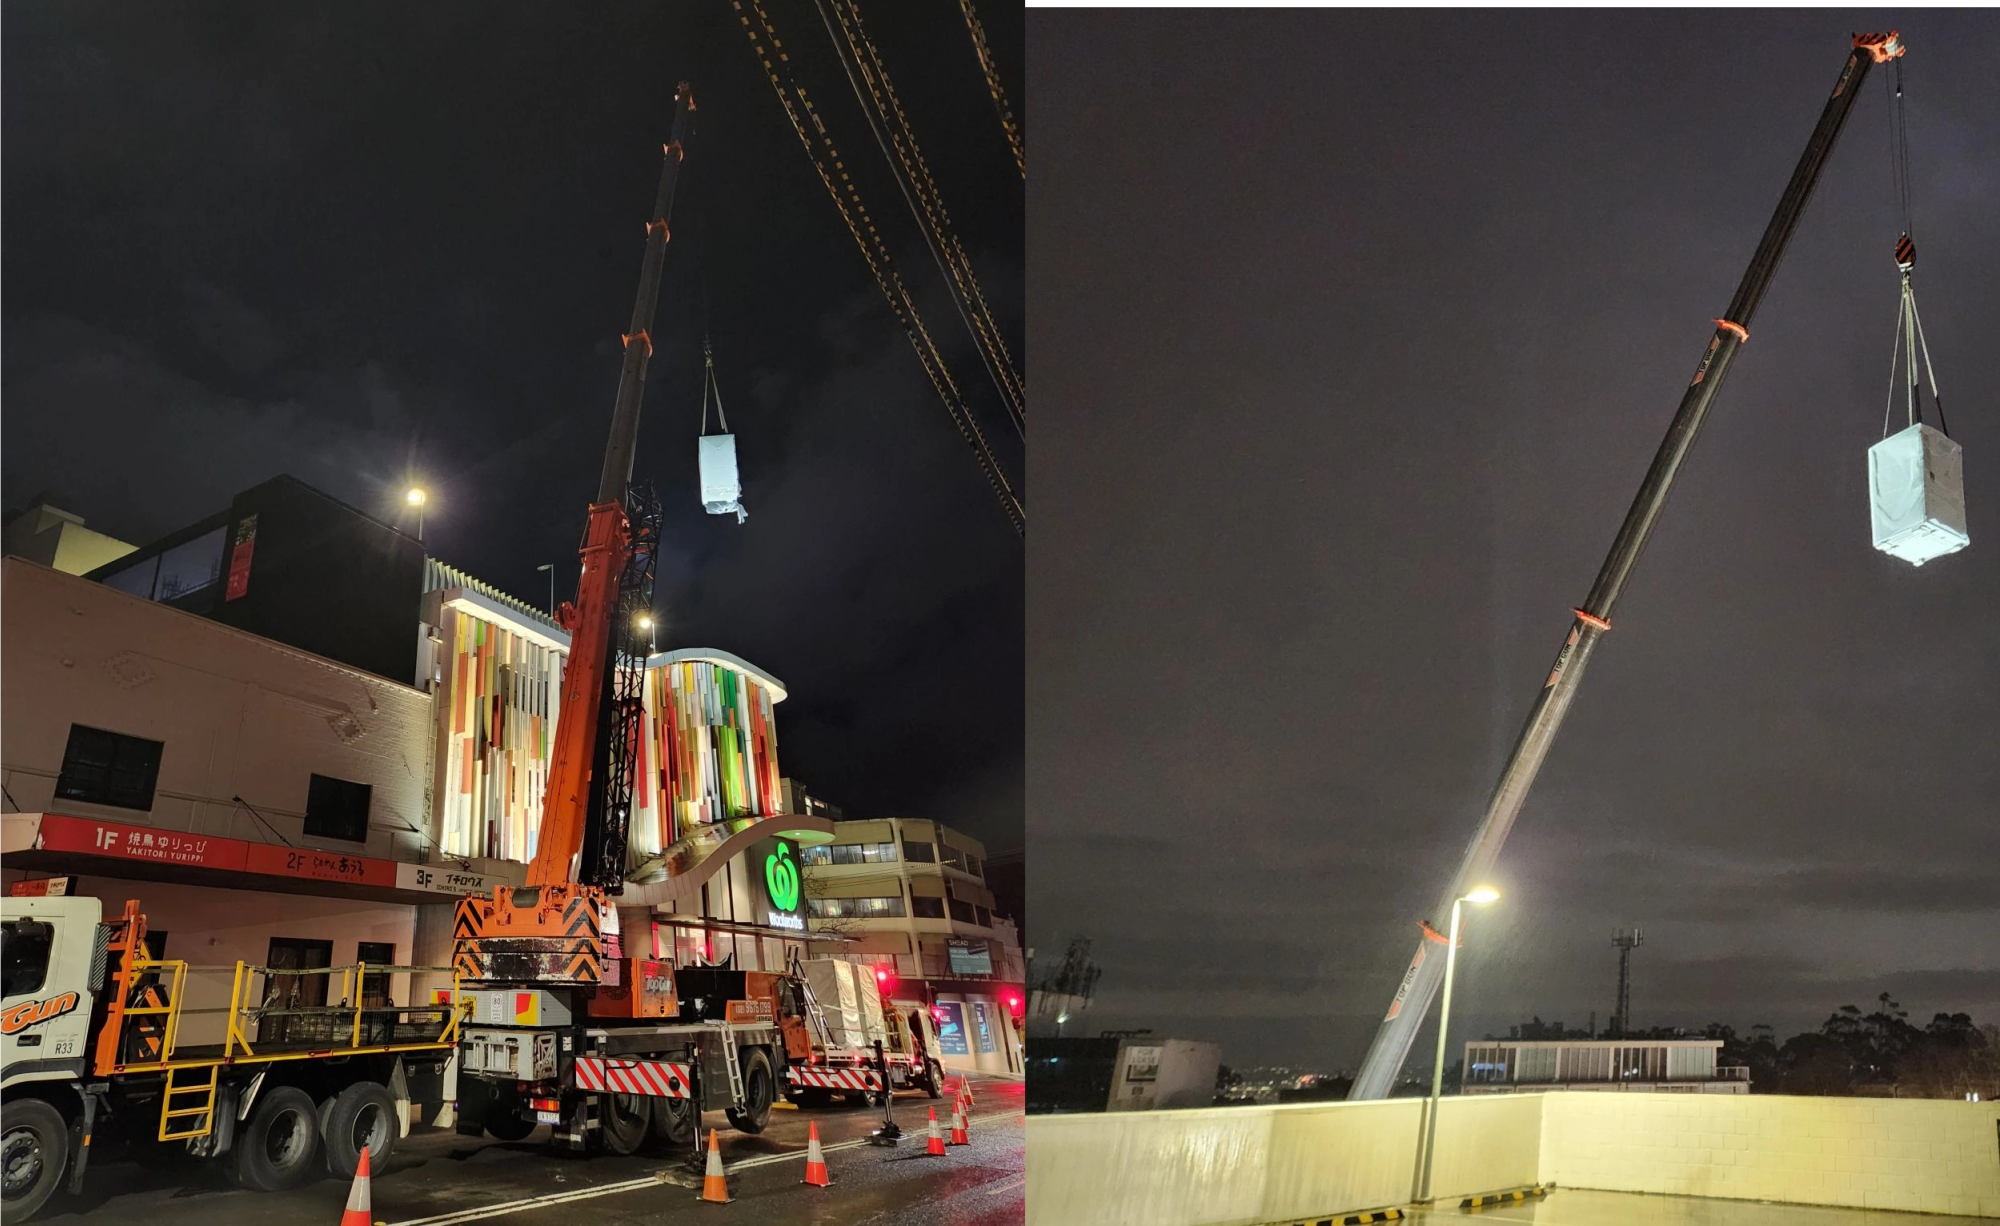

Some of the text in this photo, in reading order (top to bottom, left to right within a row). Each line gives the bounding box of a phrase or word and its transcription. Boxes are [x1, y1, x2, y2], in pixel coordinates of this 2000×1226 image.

[1561, 644, 1571, 658] GUN
[96, 827, 118, 850] 1F
[126, 846, 204, 863] YAKITORI YURIPPI
[287, 852, 306, 872] 2F
[417, 869, 433, 888] 3F
[446, 874, 484, 887] イチロウズ
[768, 912, 803, 929] Woolworths
[1405, 967, 1416, 984] GUN
[493, 997, 500, 1005] 80
[0, 991, 80, 1036] Gun
[55, 1043, 73, 1055] R33
